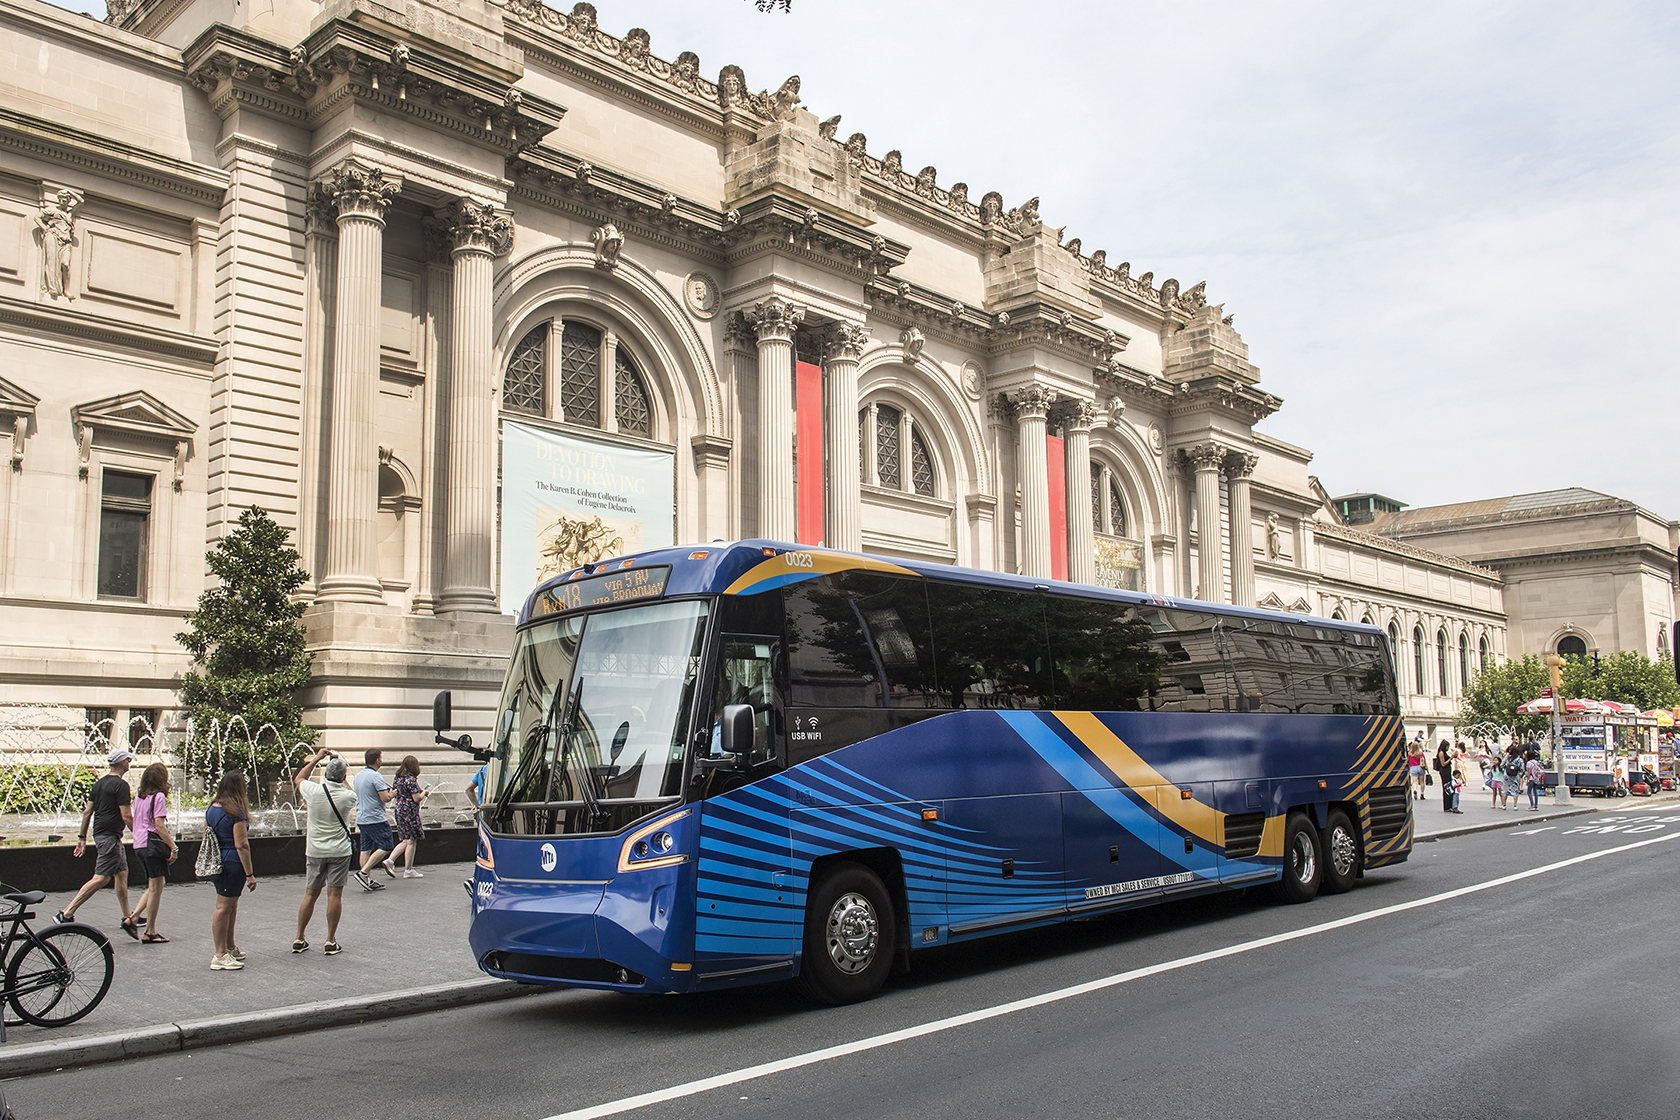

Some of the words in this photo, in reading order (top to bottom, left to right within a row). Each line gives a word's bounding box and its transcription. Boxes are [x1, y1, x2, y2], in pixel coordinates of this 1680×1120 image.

[536, 441, 616, 473] DEVOTION
[548, 462, 572, 482] TO
[575, 467, 645, 496] DRAWING
[535, 480, 549, 491] The
[549, 483, 570, 495] Karen
[577, 487, 597, 499] Cohen
[597, 491, 628, 504] Collection
[577, 497, 585, 505] of
[608, 502, 637, 514] Delacroix
[785, 551, 813, 568] 0023
[604, 579, 623, 592] VIA
[625, 572, 633, 587] 5
[635, 568, 649, 586] AV
[1095, 566, 1125, 581] EAVENLY
[791, 731, 806, 740] USB
[477, 881, 494, 897] 0023
[1085, 886, 1104, 898] OWNED
[1104, 885, 1111, 895] BY
[1111, 884, 1121, 894] MCI
[1121, 881, 1136, 892] SALES
[1136, 880, 1141, 890] &
[1141, 877, 1160, 889] SERVICE
